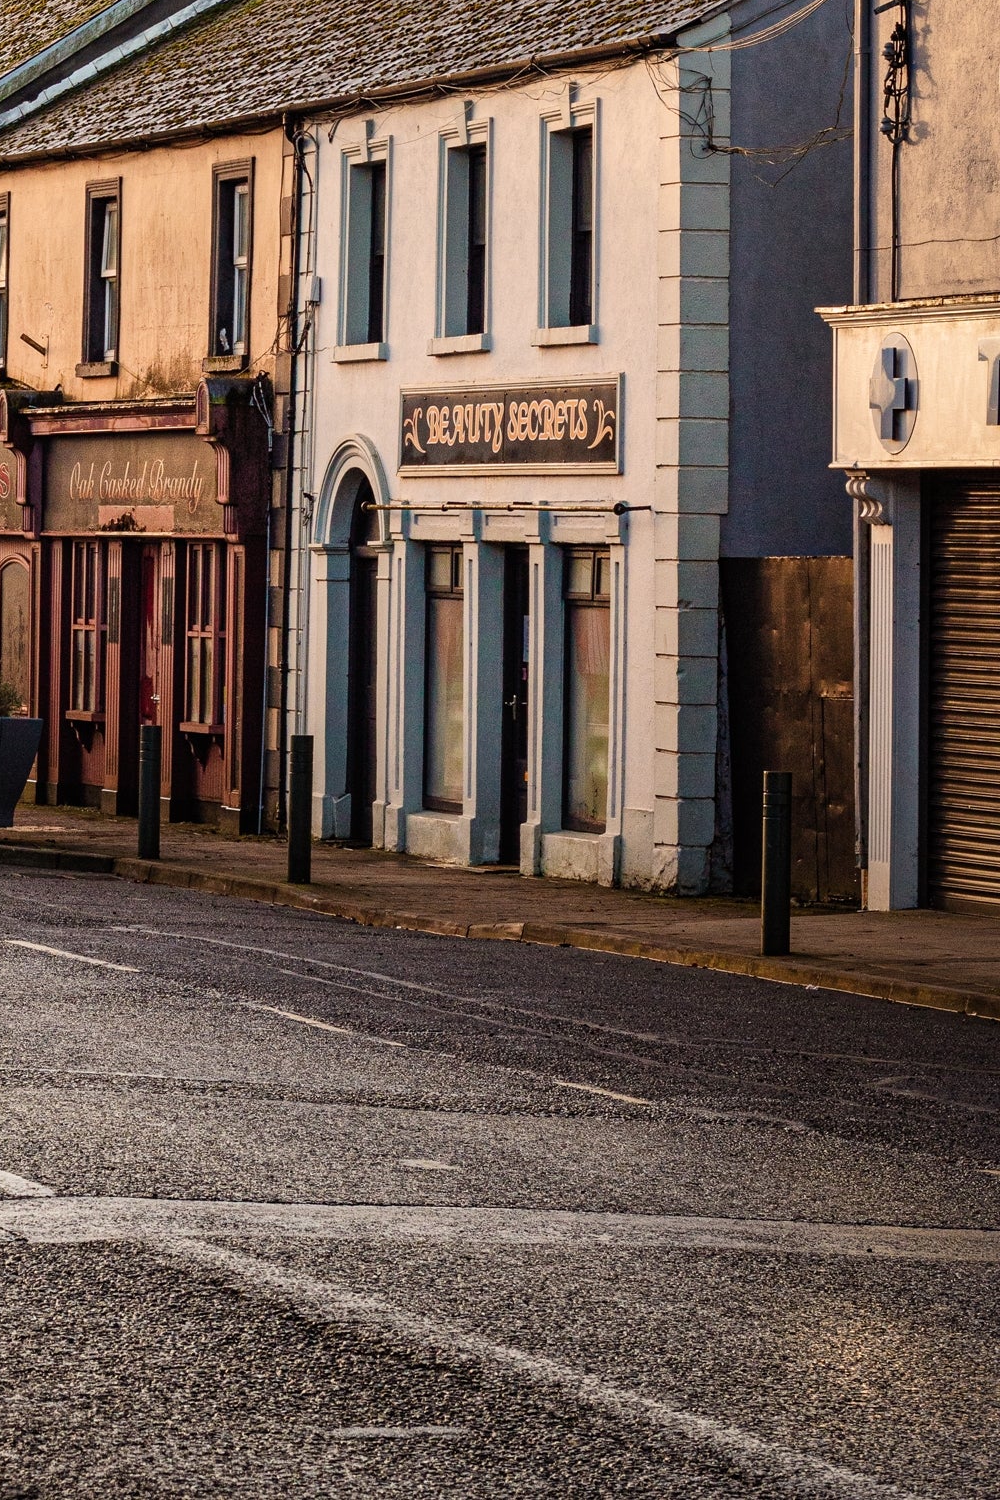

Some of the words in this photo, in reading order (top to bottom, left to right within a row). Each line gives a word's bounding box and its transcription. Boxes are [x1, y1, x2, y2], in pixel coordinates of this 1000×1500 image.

[426, 402, 505, 454] BEAUTY
[507, 398, 588, 443] SECRETS
[69, 461, 95, 501] Oak
[99, 460, 148, 501] Casked
[149, 458, 204, 514] Brandy
